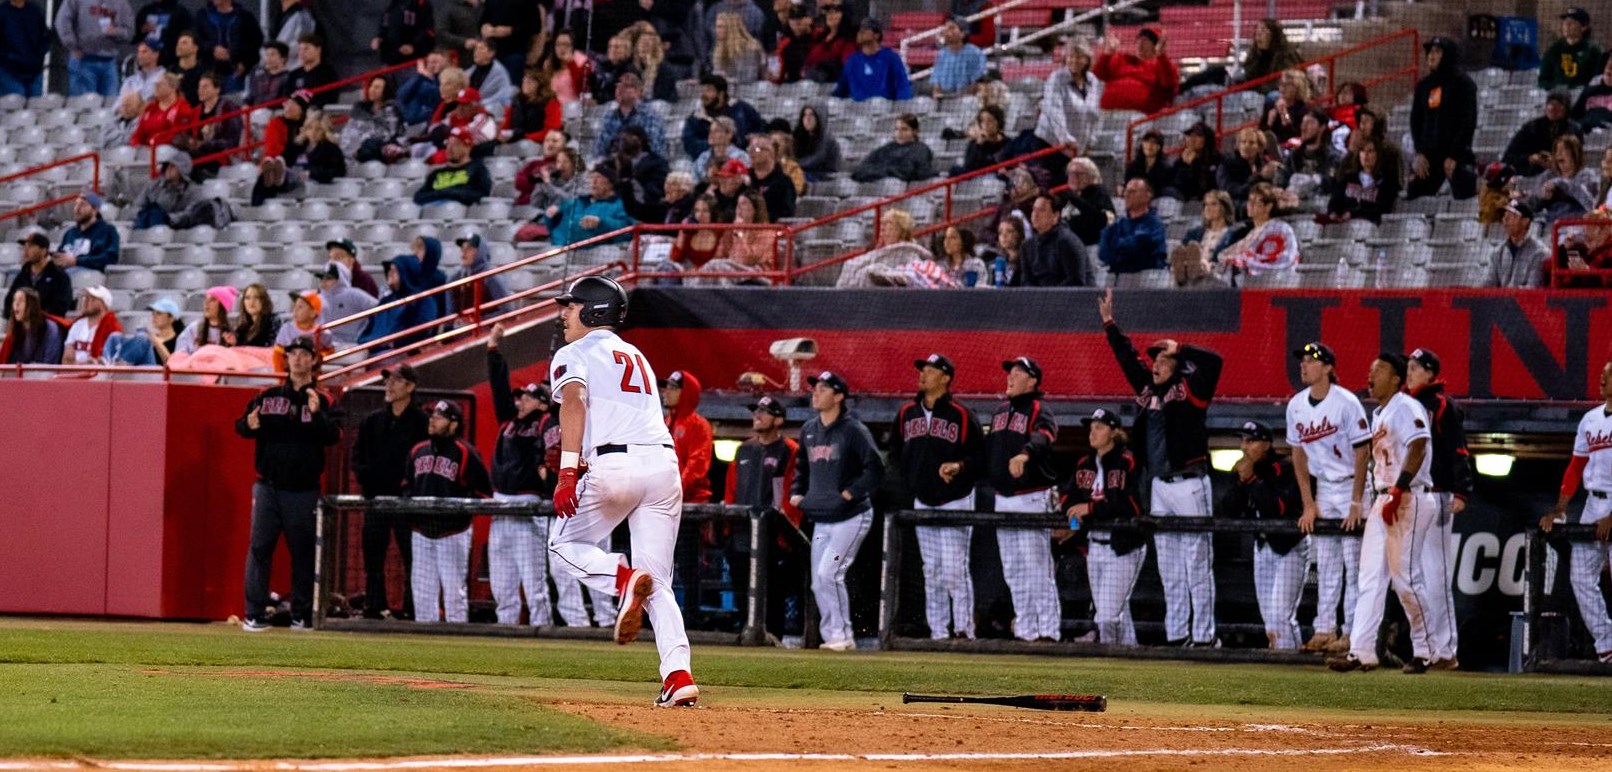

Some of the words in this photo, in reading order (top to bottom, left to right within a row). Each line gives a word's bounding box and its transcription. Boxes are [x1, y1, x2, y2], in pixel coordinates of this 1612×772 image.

[612, 350, 652, 395] 21
[903, 416, 959, 443] REBELS
[1295, 415, 1338, 443] Rebels
[414, 454, 459, 481] REBELS
